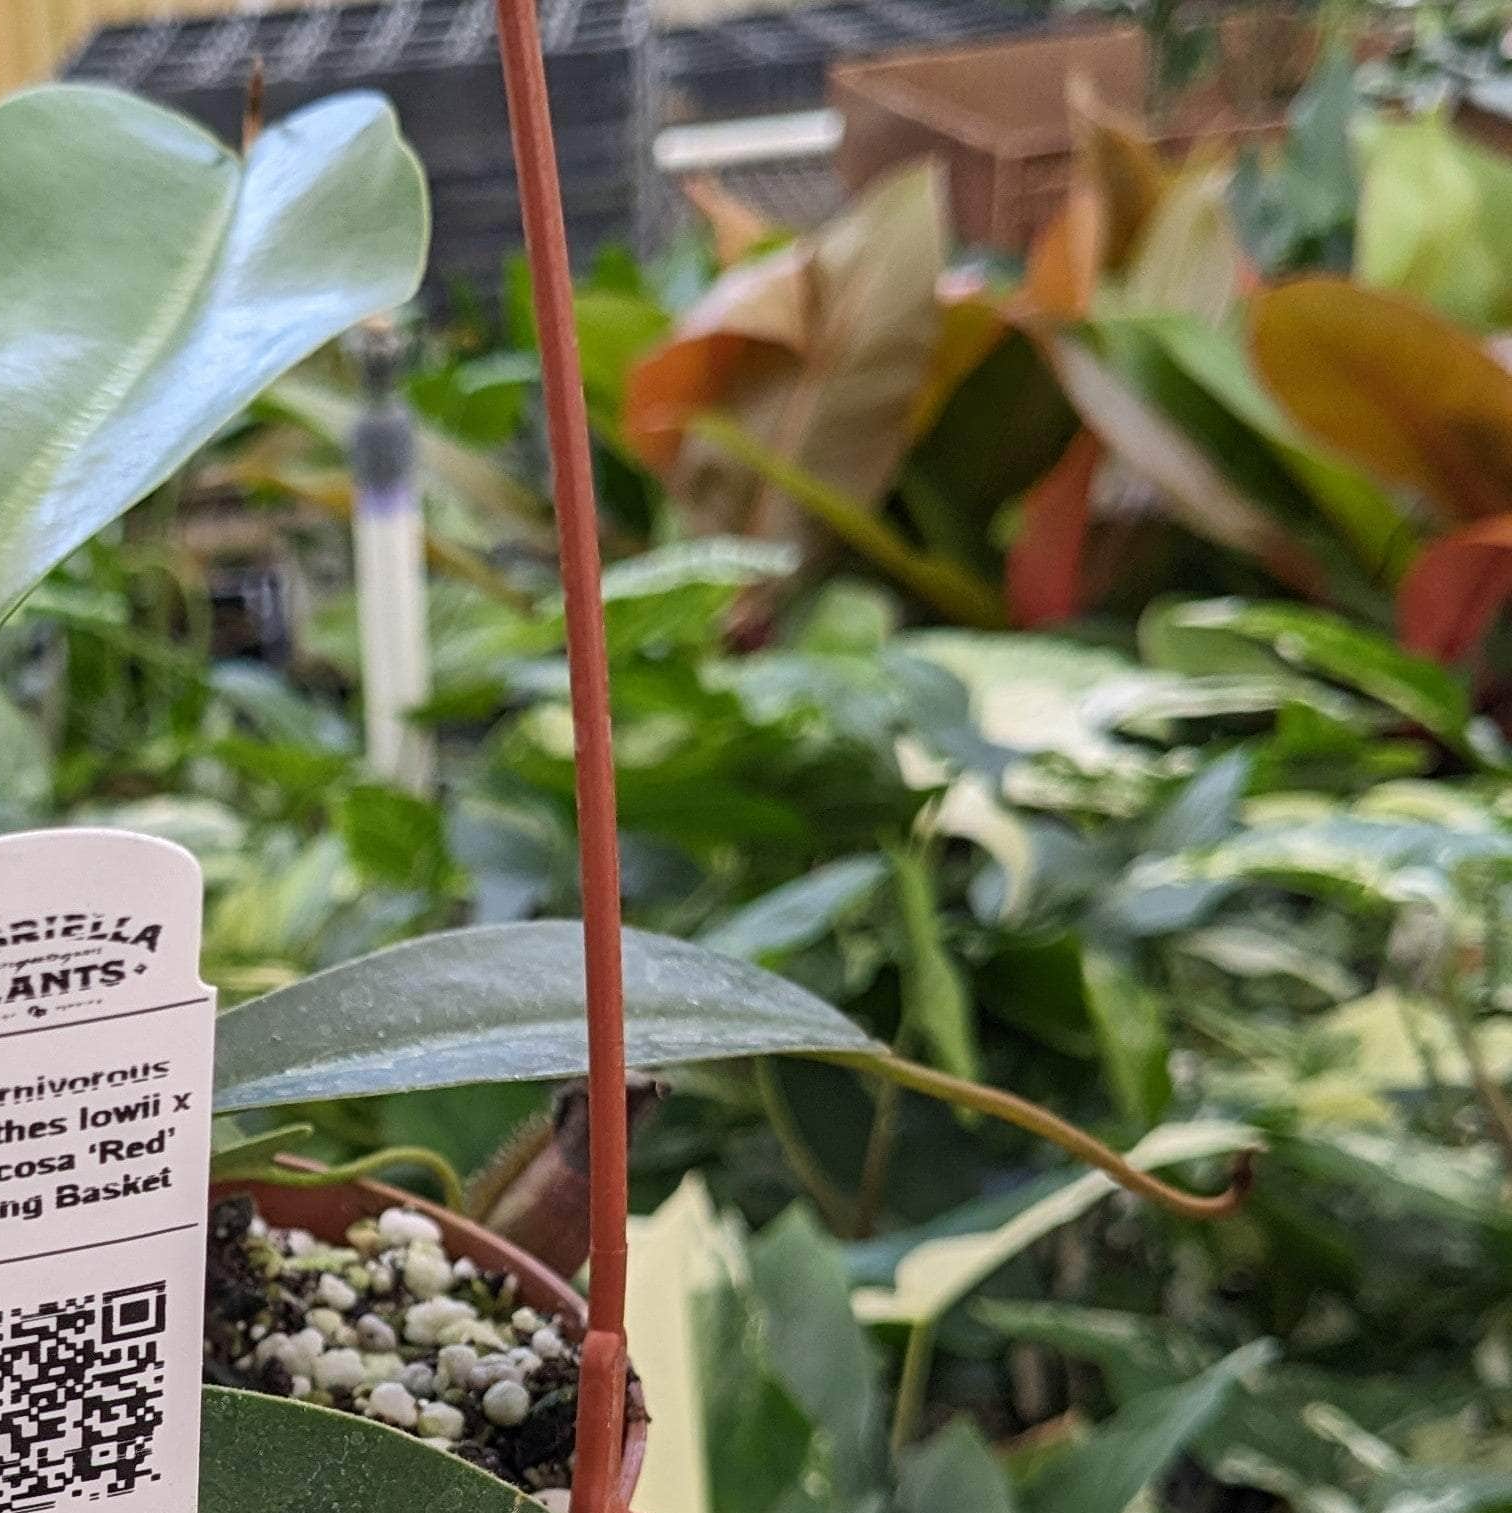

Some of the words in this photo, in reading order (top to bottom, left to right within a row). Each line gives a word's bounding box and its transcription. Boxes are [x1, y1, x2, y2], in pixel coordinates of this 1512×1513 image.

[79, 1093, 161, 1131] lowii
[172, 1092, 192, 1112] x
[55, 1165, 174, 1210] Basket
